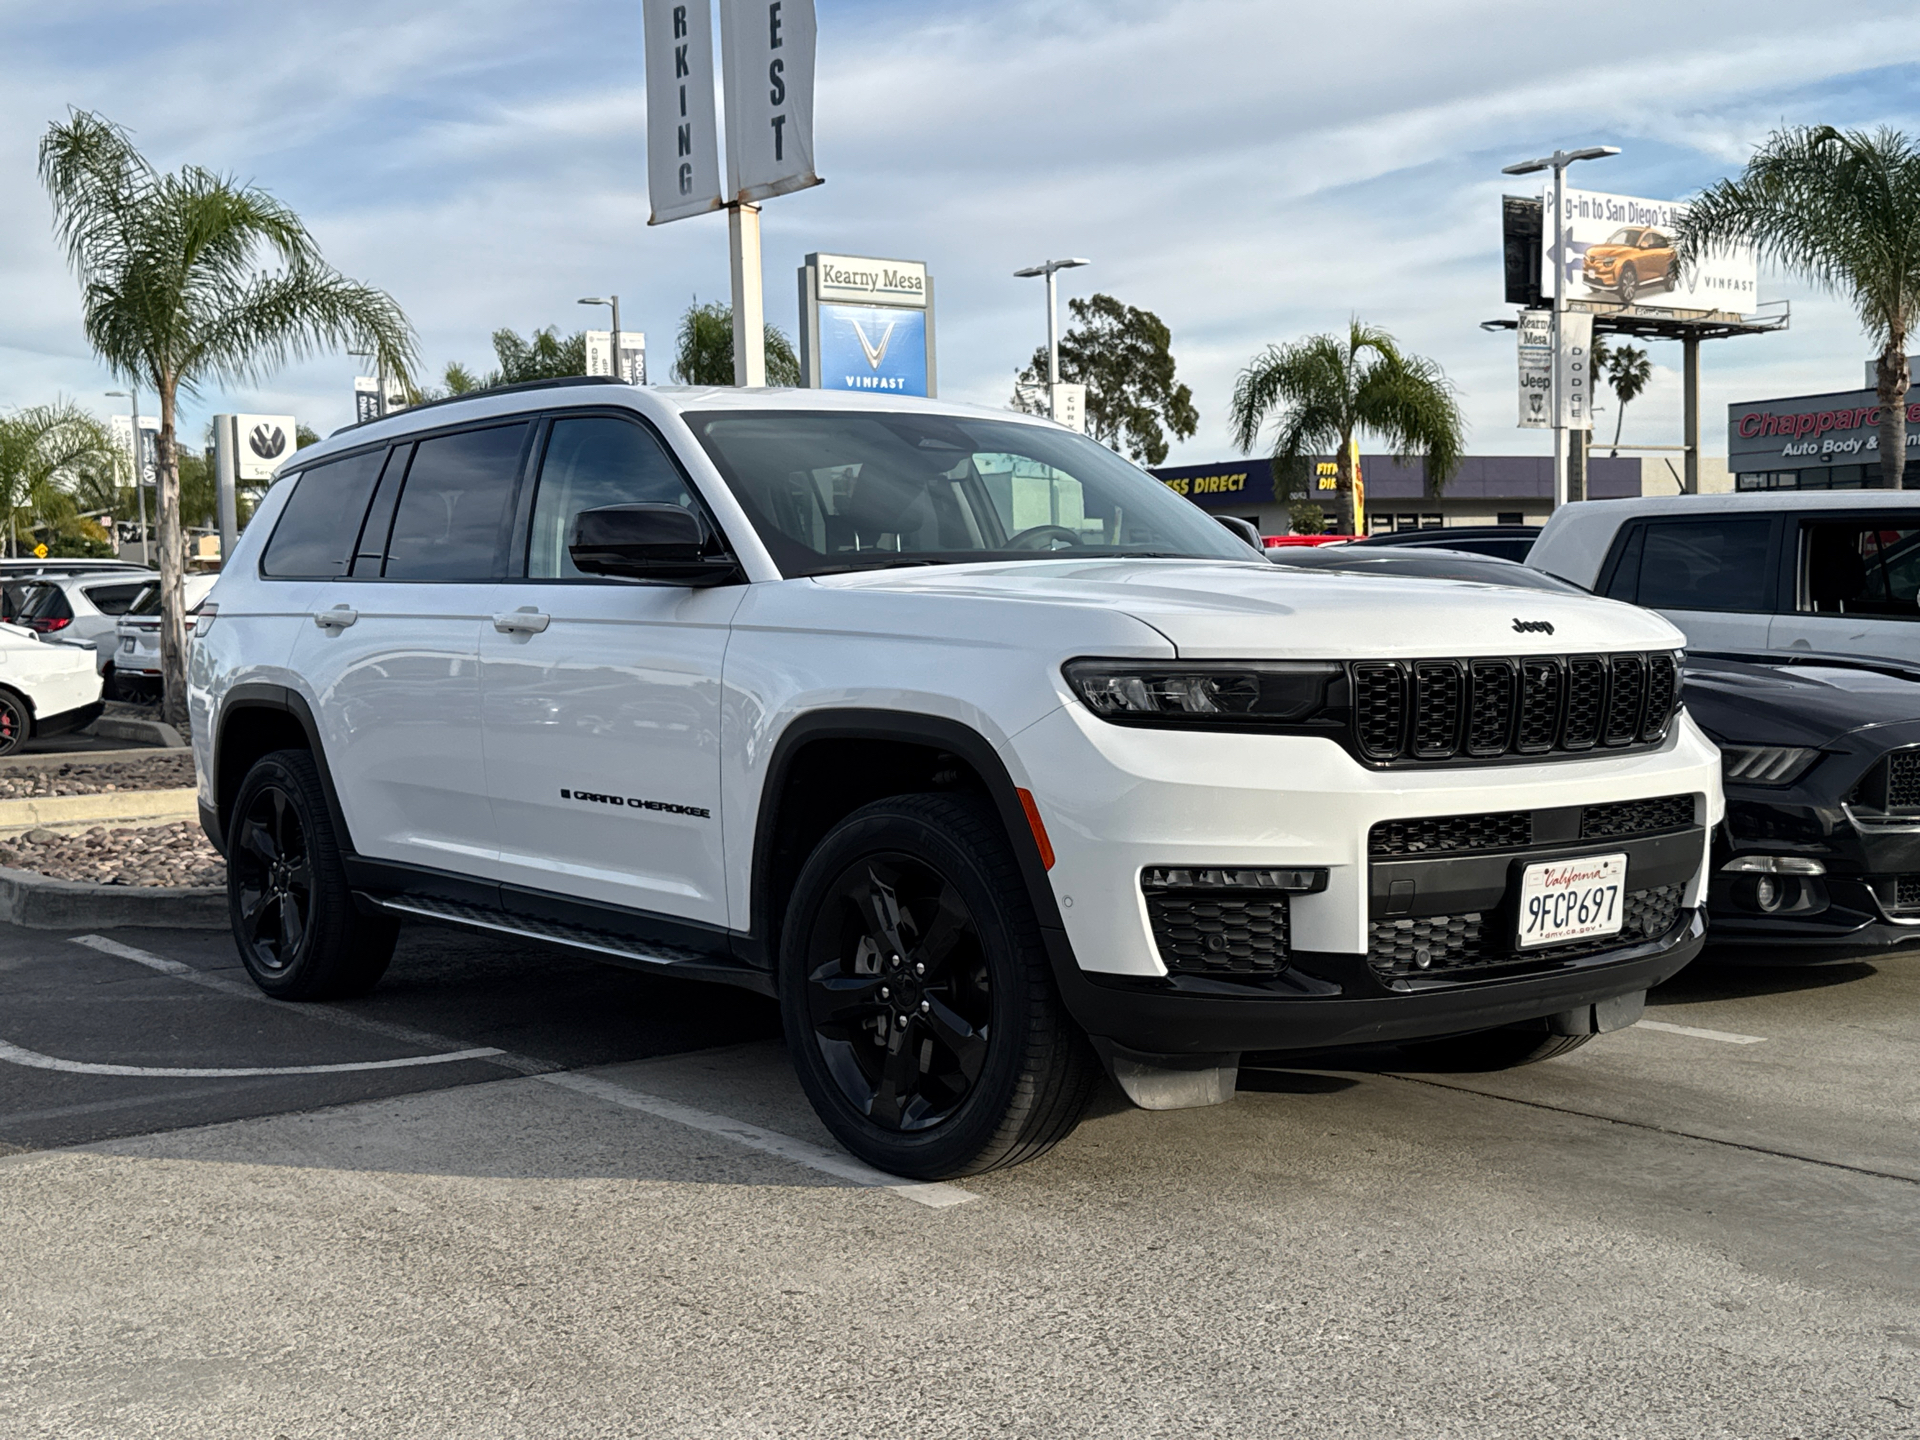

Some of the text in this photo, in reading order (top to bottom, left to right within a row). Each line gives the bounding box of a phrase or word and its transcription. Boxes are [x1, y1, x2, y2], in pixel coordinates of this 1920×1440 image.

[769, 1, 787, 161] EST
[1547, 191, 1590, 219] Pg-in
[1592, 198, 1604, 220] to
[1606, 198, 1626, 222] San
[1628, 201, 1667, 228] Diego's
[823, 264, 923, 293] Kearny Mesa
[1704, 276, 1754, 292] VINFAST
[1519, 315, 1551, 333] Kearny
[1523, 331, 1547, 345] Mesa
[845, 376, 905, 390] VINFAST
[1521, 373, 1551, 391] Jeep
[1571, 347, 1582, 418] DODGE
[1782, 441, 1818, 457] Auto
[1822, 436, 1863, 455] Body
[1866, 434, 1878, 450] &
[1193, 473, 1248, 494] DIRECT
[1511, 617, 1555, 636] Jeep
[573, 790, 711, 819] GRAND CHEROKEE
[1545, 866, 1607, 890] California
[1527, 885, 1618, 933] 9FCP697
[1545, 925, 1596, 939] dmv.ca.gov
